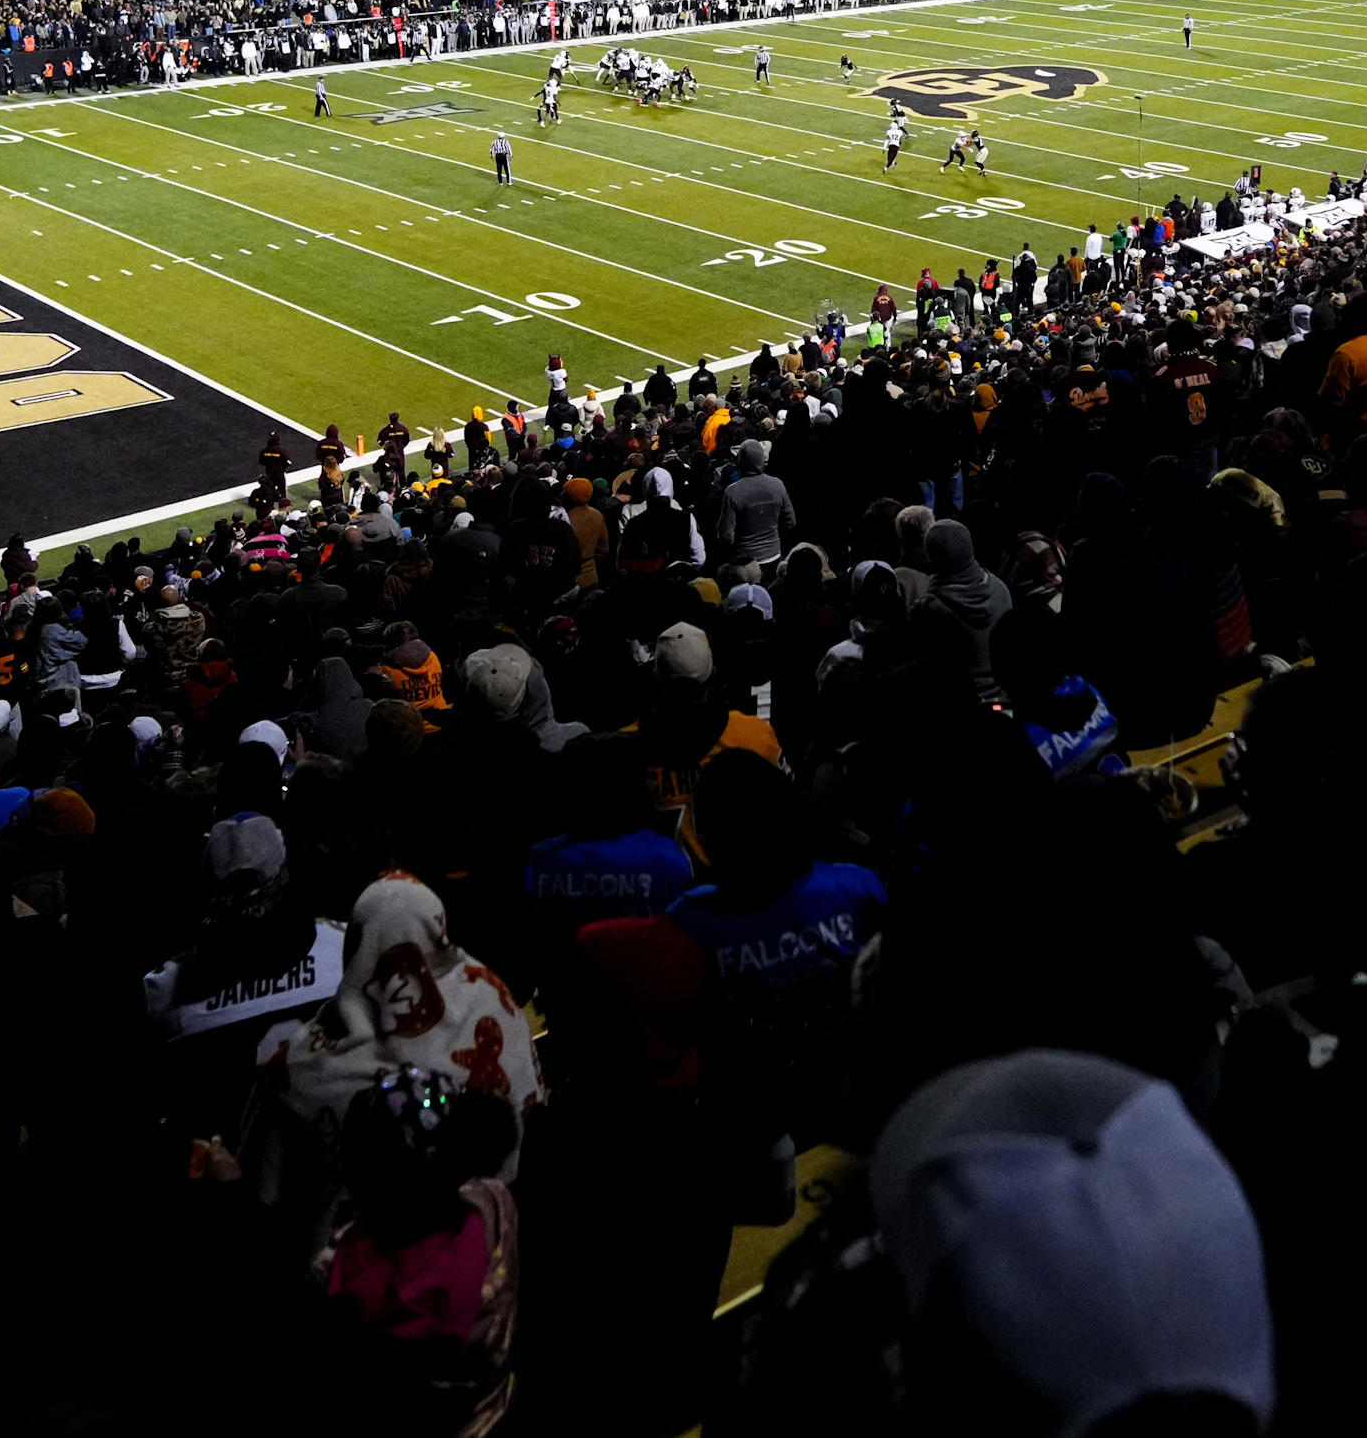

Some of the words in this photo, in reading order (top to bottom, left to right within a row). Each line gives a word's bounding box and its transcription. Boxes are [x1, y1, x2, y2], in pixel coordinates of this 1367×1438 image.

[1254, 132, 1329, 148] 50
[1117, 161, 1191, 181] 40
[936, 197, 1026, 220] 30
[724, 239, 827, 268] 20
[460, 292, 582, 325] 10
[403, 684, 442, 702] DEVIL
[538, 872, 653, 899] FALCONS
[716, 912, 854, 977] FALCONS
